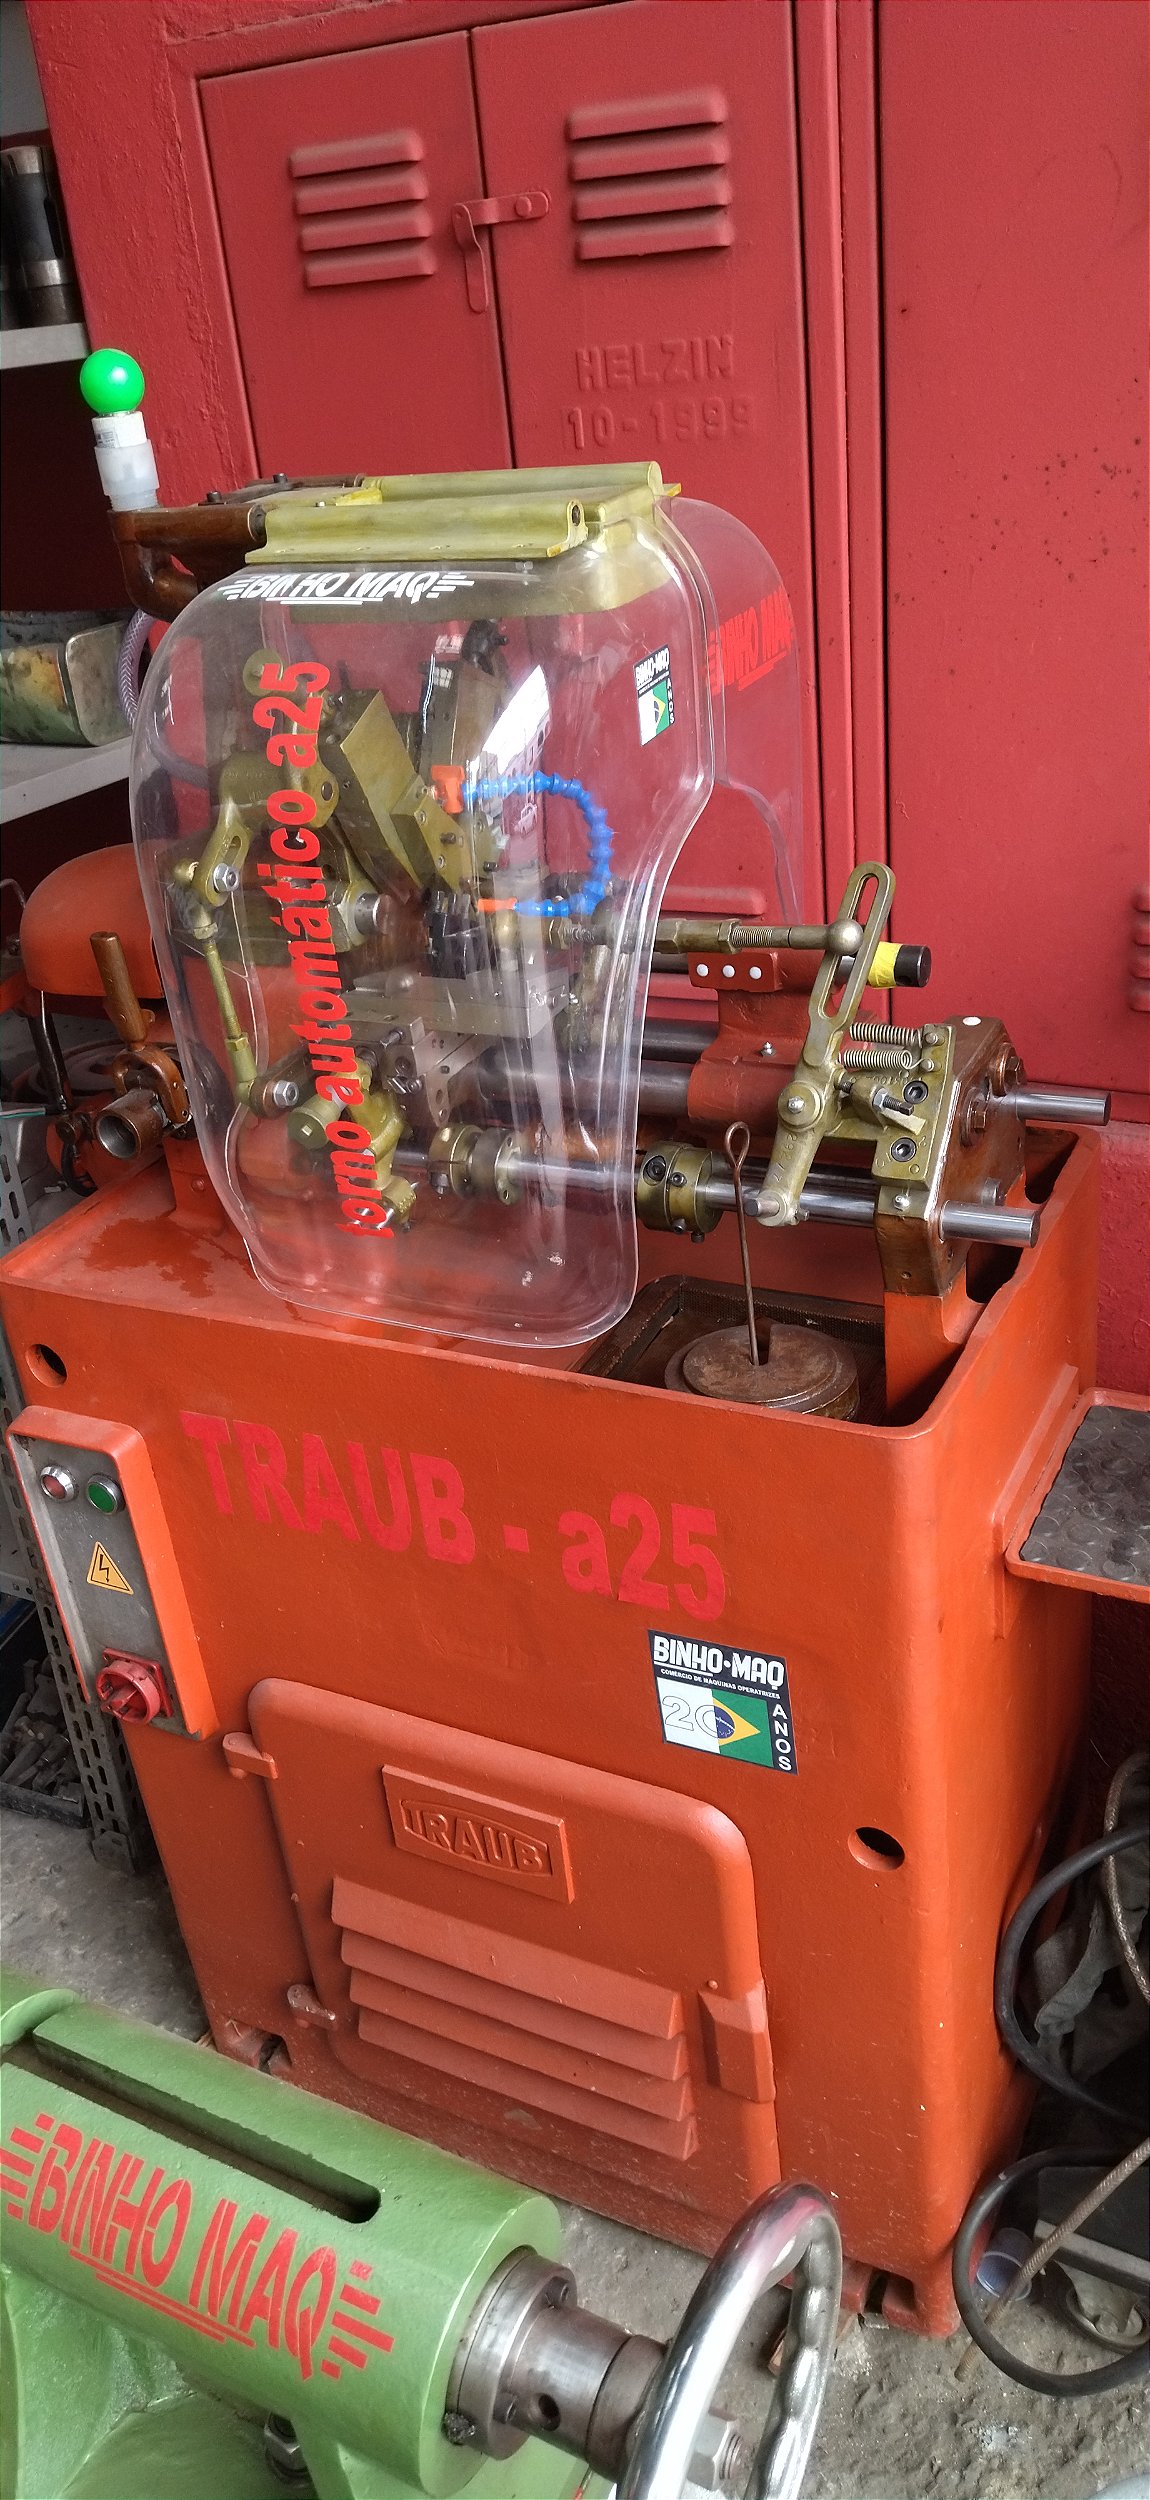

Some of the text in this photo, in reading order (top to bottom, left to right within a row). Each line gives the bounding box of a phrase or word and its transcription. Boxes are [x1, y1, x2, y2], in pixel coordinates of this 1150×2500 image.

[575, 335, 734, 391] HELZIN
[240, 572, 441, 604] BINHO MAQ
[252, 661, 394, 1239] torno automático a25
[180, 1410, 476, 1565] TRAUB
[558, 1491, 726, 1622] a25
[772, 1703, 792, 1771] ANOS
[402, 1803, 544, 1872] TRAUB
[28, 2123, 338, 2381] BINHO MAQ
